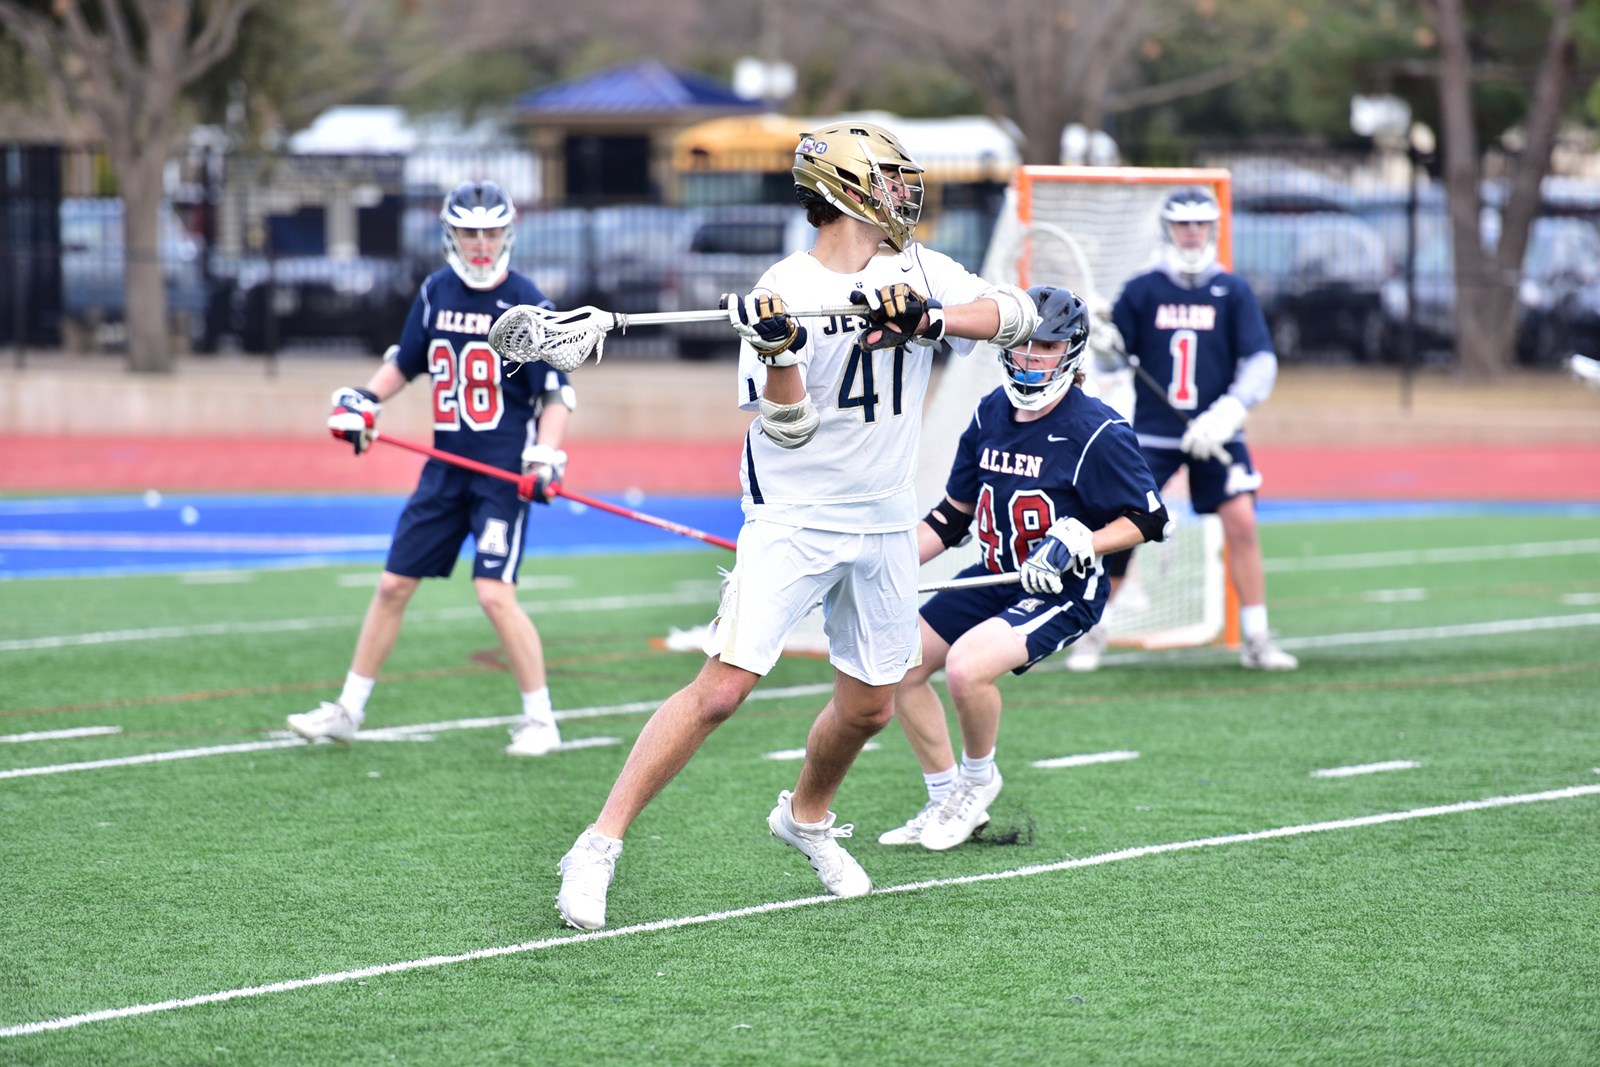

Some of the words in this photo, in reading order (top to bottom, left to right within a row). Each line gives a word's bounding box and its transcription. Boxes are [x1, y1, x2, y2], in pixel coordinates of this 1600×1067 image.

[815, 142, 827, 154] 21
[435, 309, 493, 335] ALLEN
[1155, 304, 1216, 331] ALLEN
[428, 338, 505, 432] 28
[836, 342, 904, 425] 41
[1169, 329, 1198, 410] 1
[979, 447, 1043, 478] ALLEN
[975, 482, 1058, 573] 48
